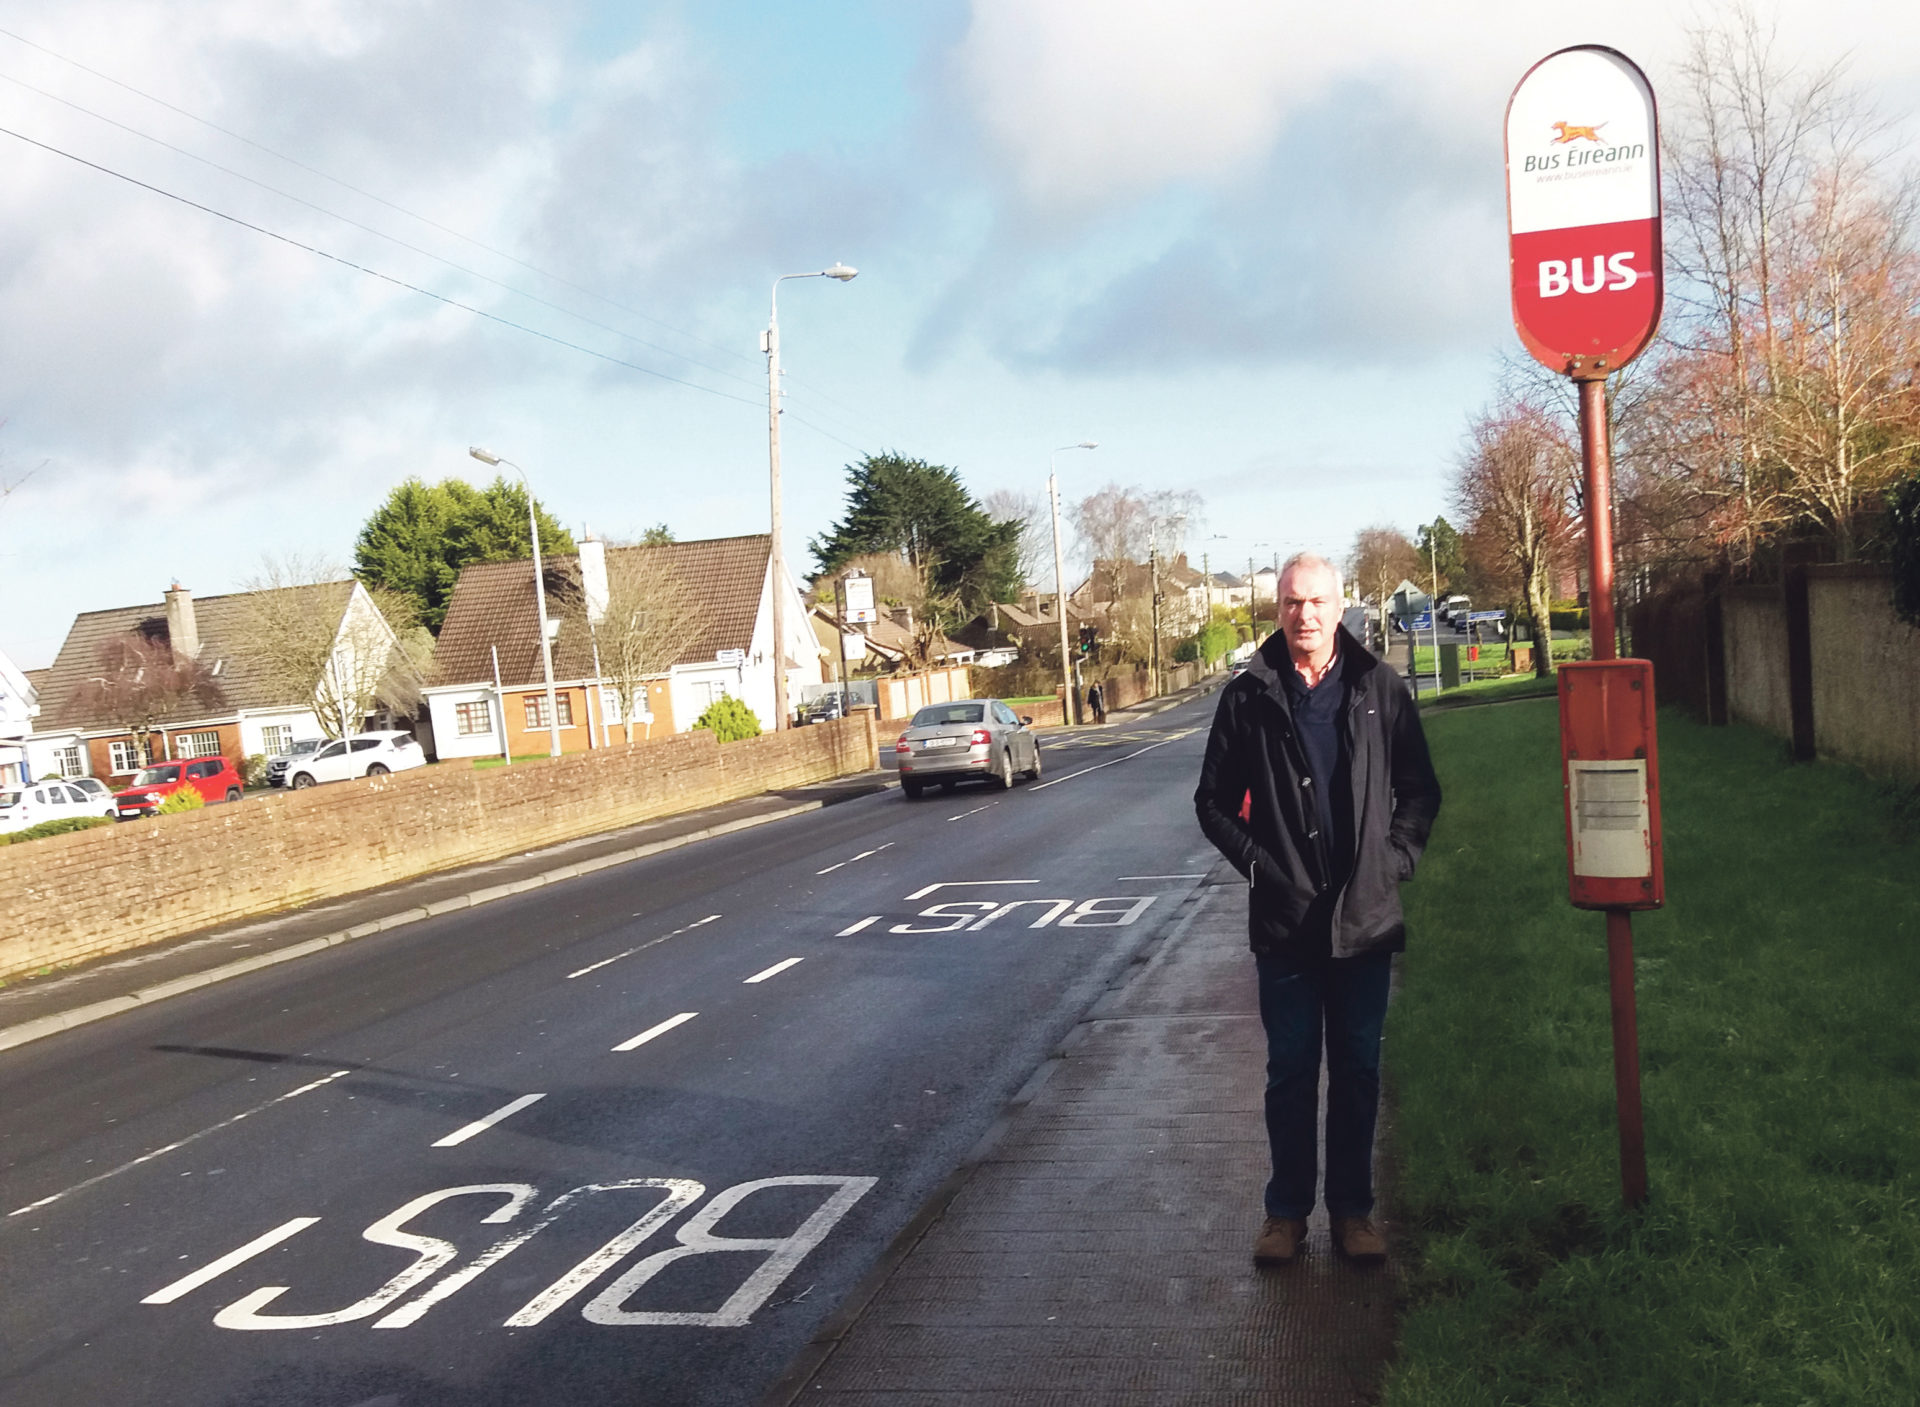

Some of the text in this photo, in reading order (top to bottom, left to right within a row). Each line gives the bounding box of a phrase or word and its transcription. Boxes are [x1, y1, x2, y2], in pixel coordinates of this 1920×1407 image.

[1524, 144, 1644, 172] Bus Éireann
[1538, 251, 1638, 298] BUS
[889, 896, 1158, 934] BUS
[212, 1175, 880, 1330] BUS
